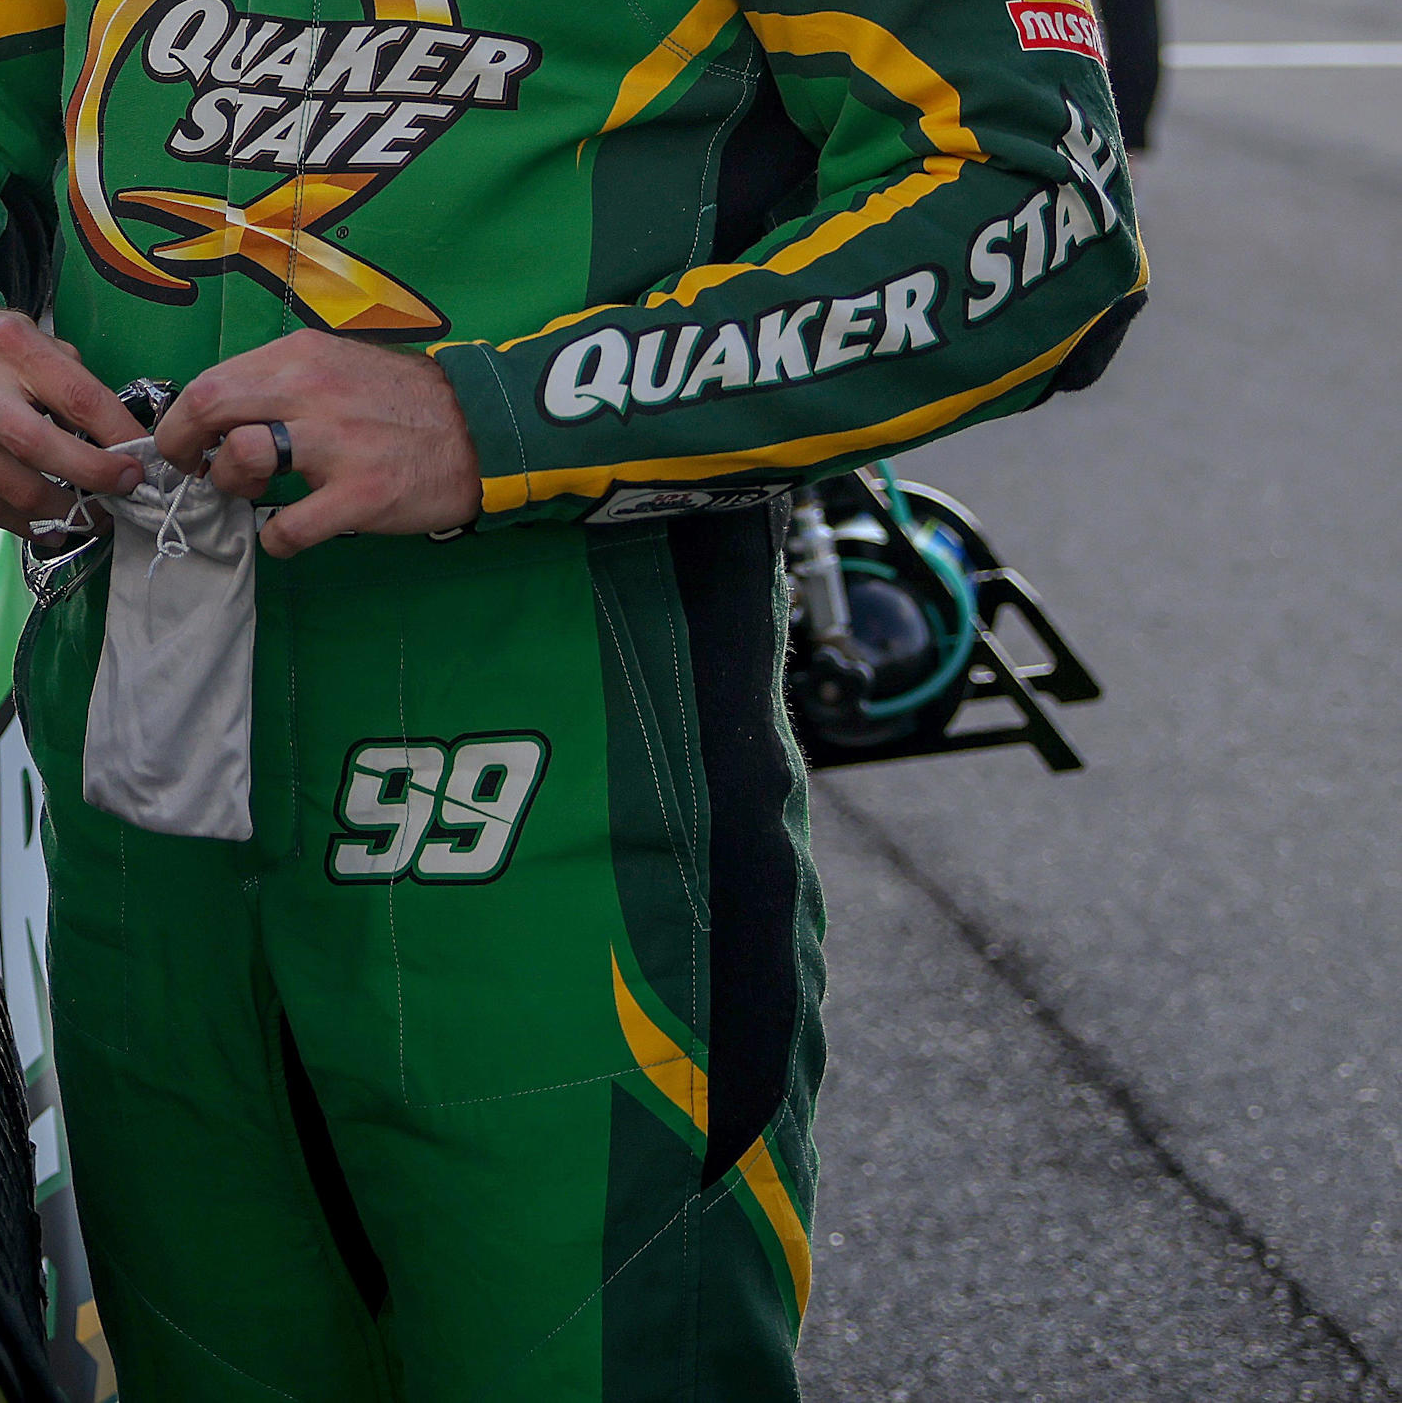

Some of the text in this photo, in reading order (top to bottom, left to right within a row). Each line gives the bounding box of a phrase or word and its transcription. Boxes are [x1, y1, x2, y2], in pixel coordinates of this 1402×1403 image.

[170, 87, 457, 167] STATE
[543, 269, 940, 419] QUAKER
[332, 738, 544, 877] 99
